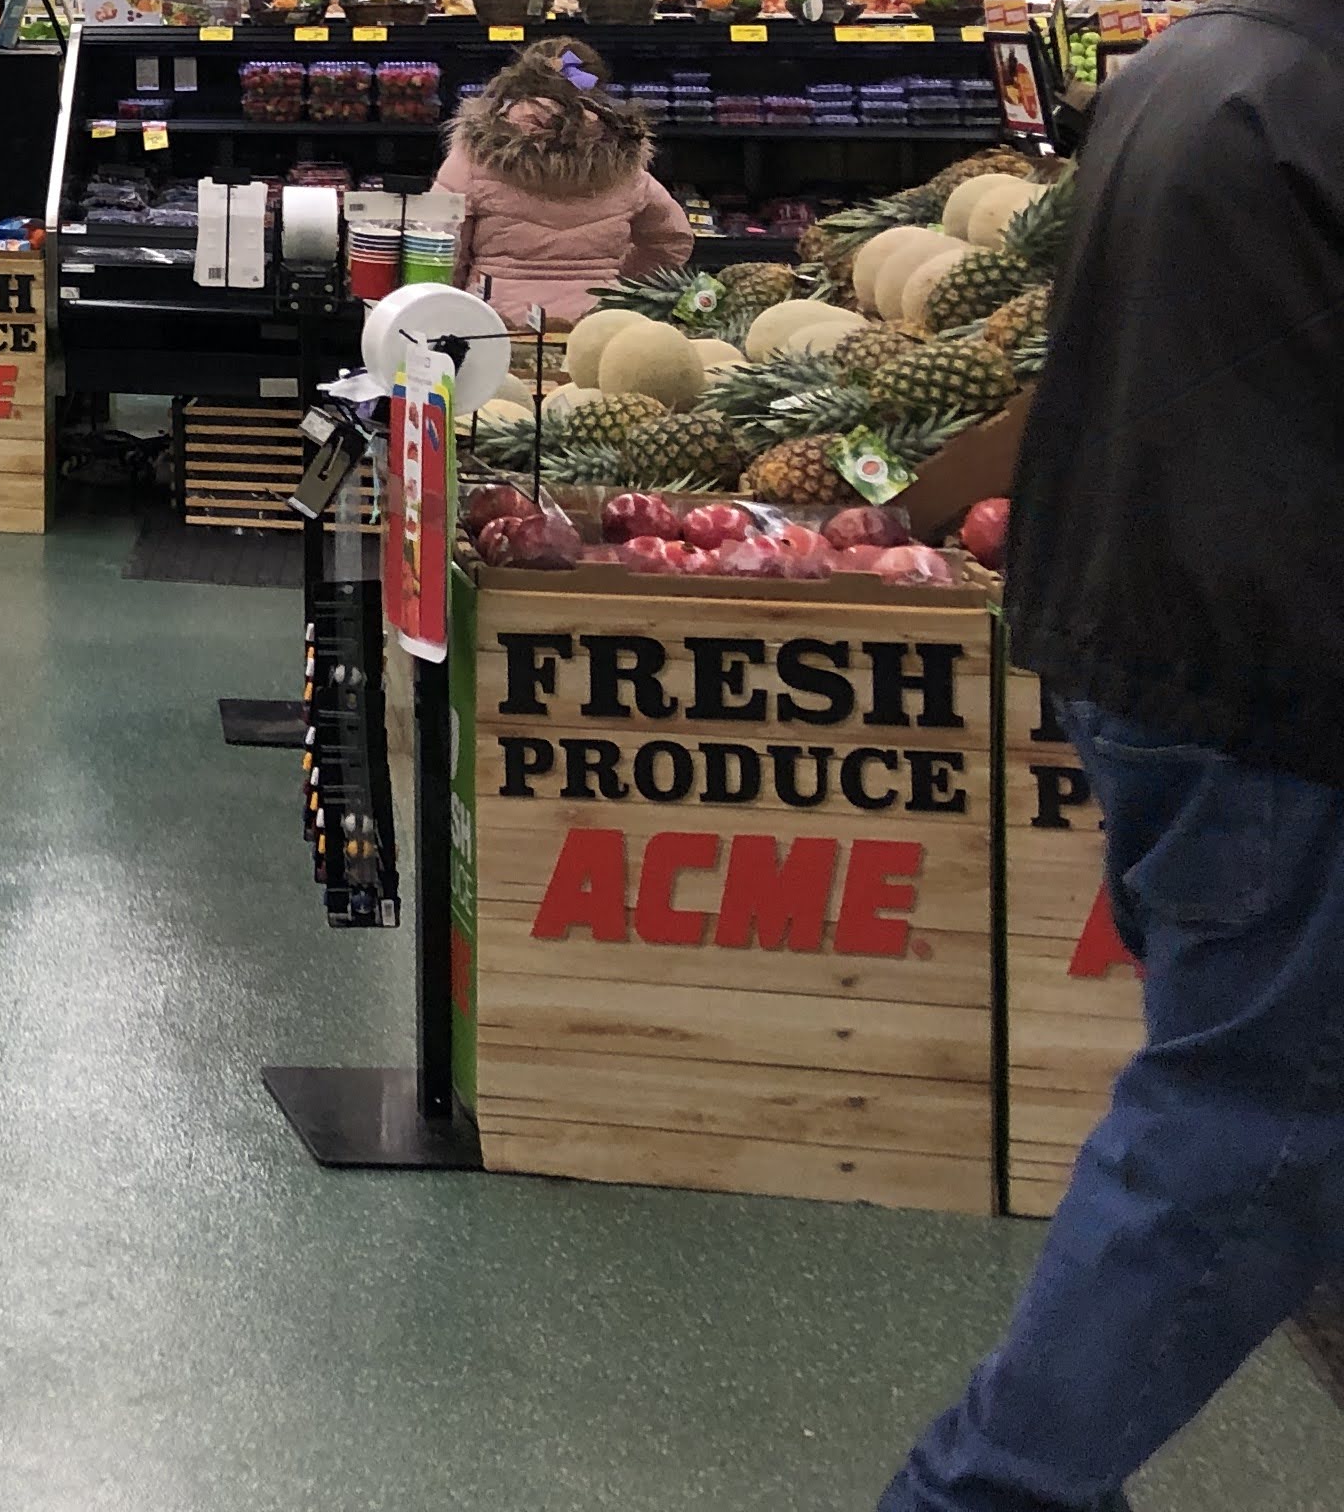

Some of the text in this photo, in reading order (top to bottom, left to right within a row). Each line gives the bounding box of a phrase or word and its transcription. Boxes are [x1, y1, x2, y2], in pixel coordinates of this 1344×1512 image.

[497, 633, 965, 728] FRESH
[498, 737, 967, 814] PRODUCE
[530, 828, 924, 957] ACME
